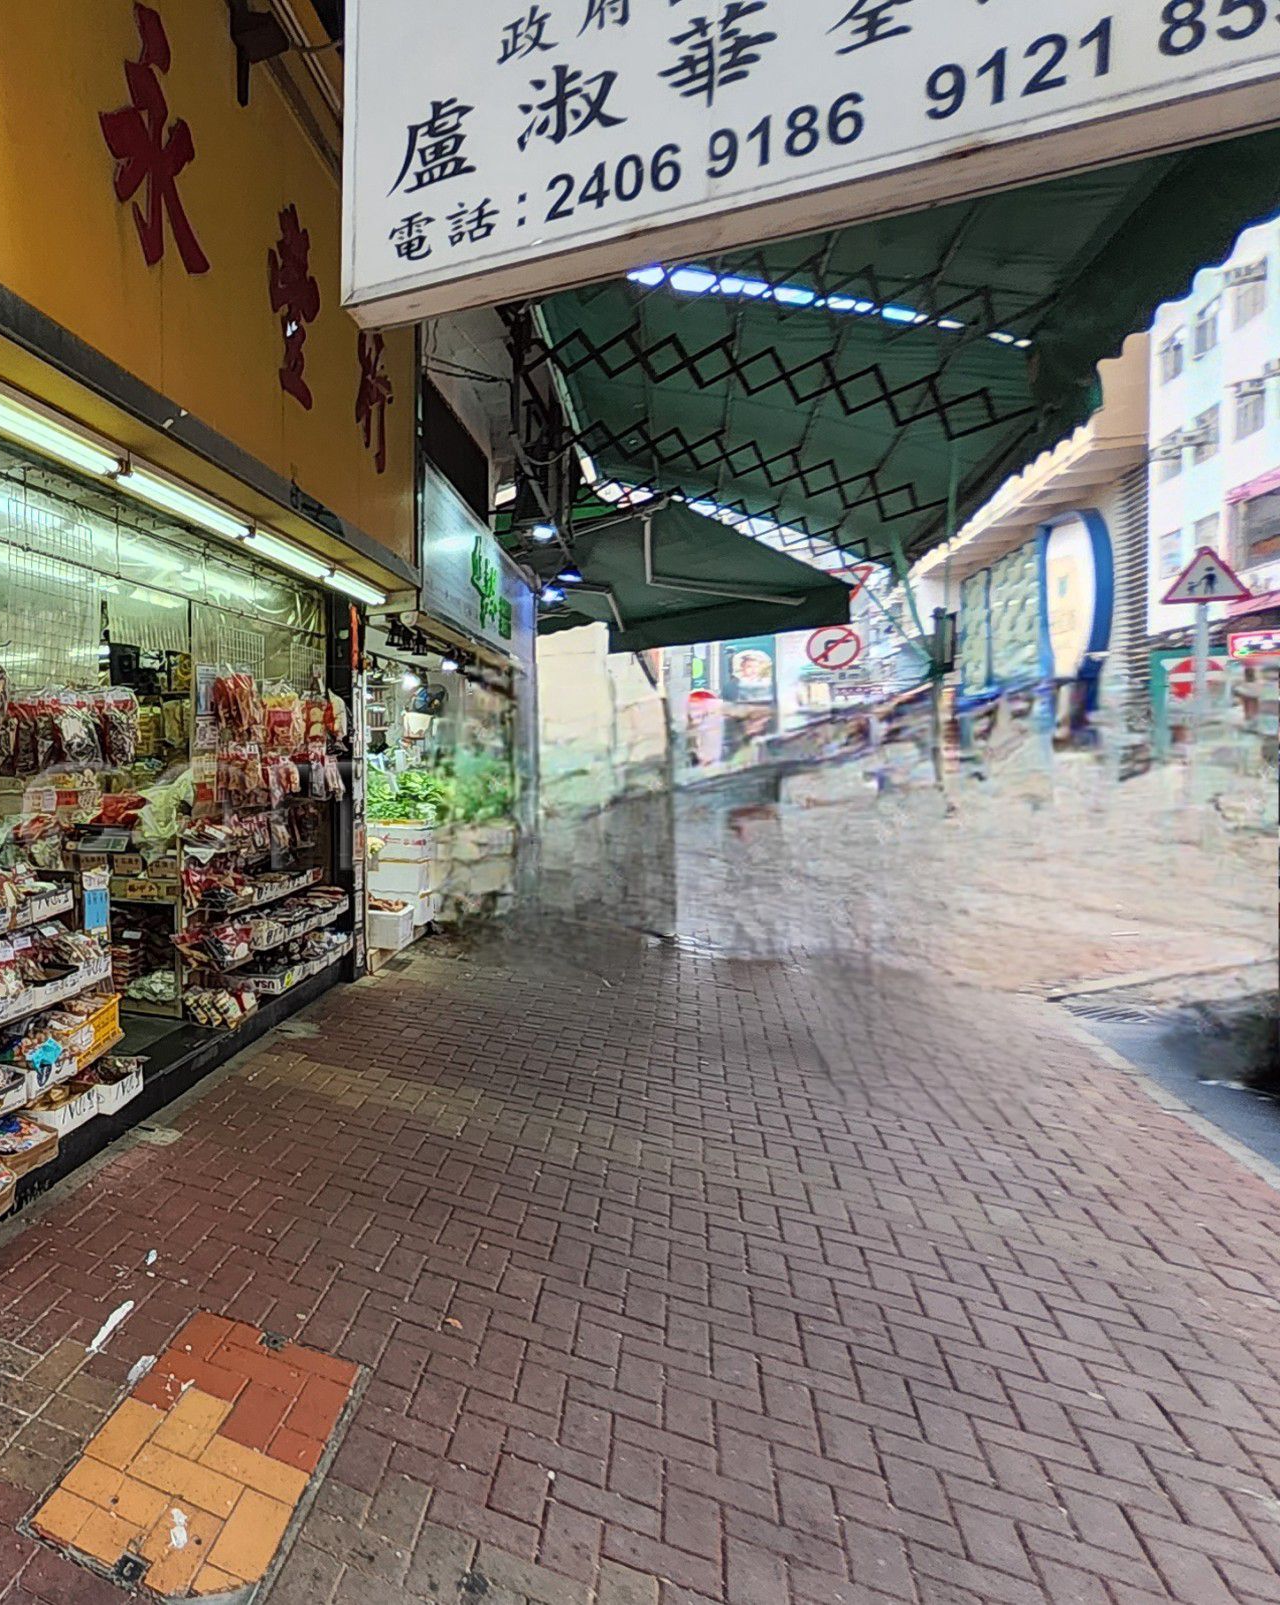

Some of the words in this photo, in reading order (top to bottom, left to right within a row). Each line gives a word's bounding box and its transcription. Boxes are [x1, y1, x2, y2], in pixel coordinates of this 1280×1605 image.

[544, 143, 681, 224] 2406
[705, 93, 866, 179] 9186
[925, 15, 1114, 121] 9121
[1157, 0, 1280, 57] 85
